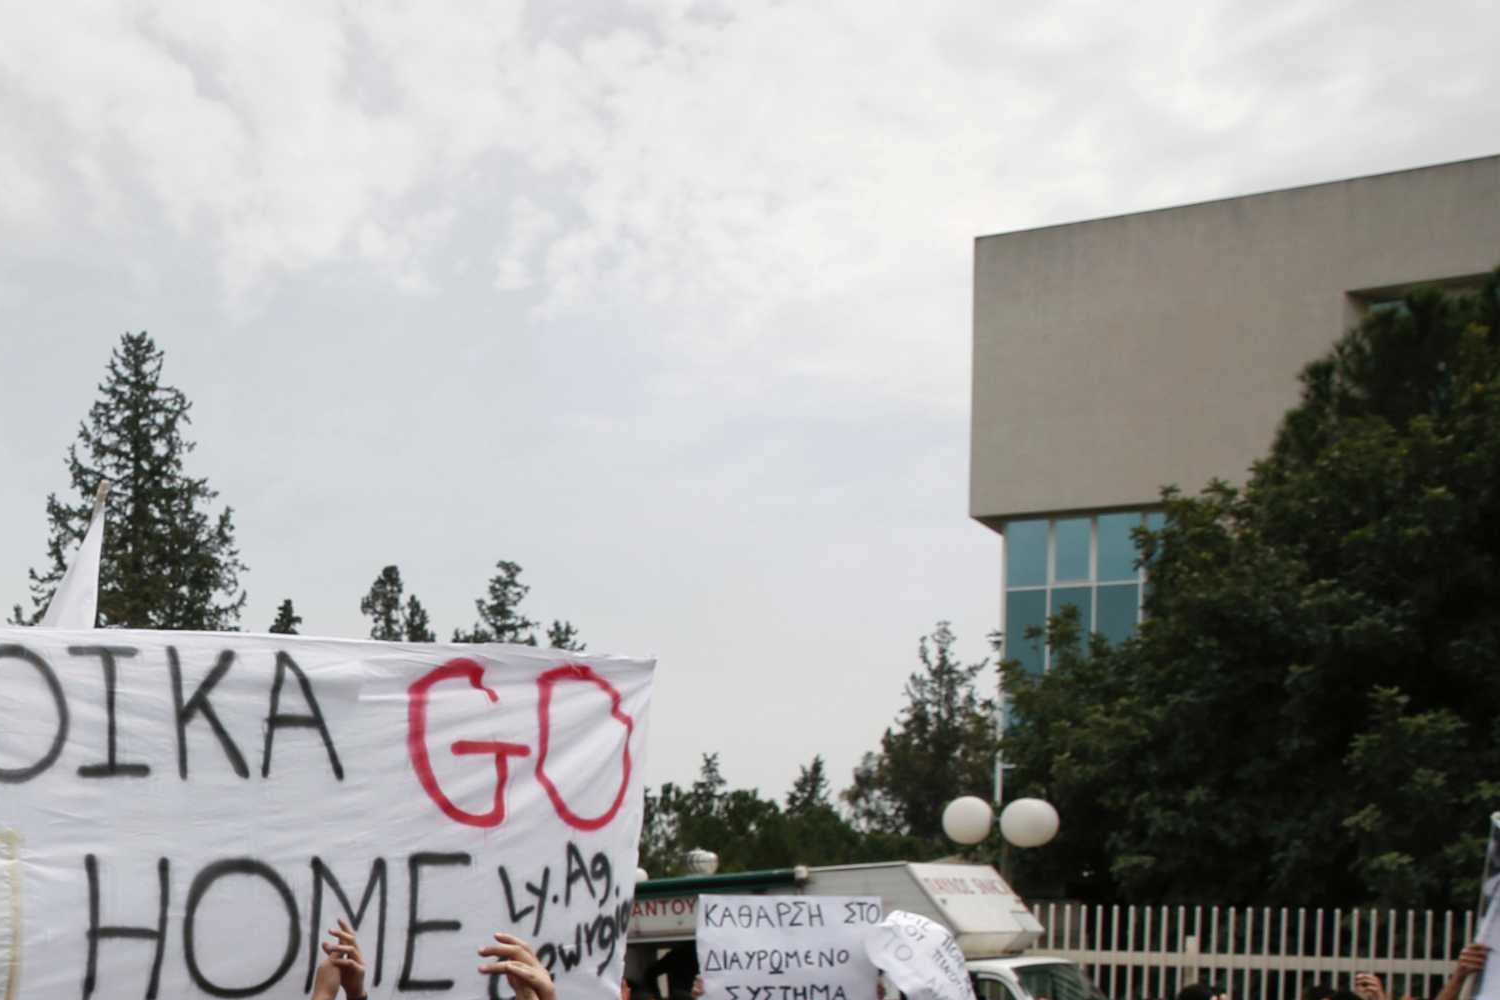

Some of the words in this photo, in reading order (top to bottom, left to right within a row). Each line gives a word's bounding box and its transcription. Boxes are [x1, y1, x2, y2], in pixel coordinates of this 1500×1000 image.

[406, 657, 635, 832] GO
[704, 901, 824, 928] ΚΑΘΑΡΣΗ
[843, 901, 881, 925] ΣΤΟ
